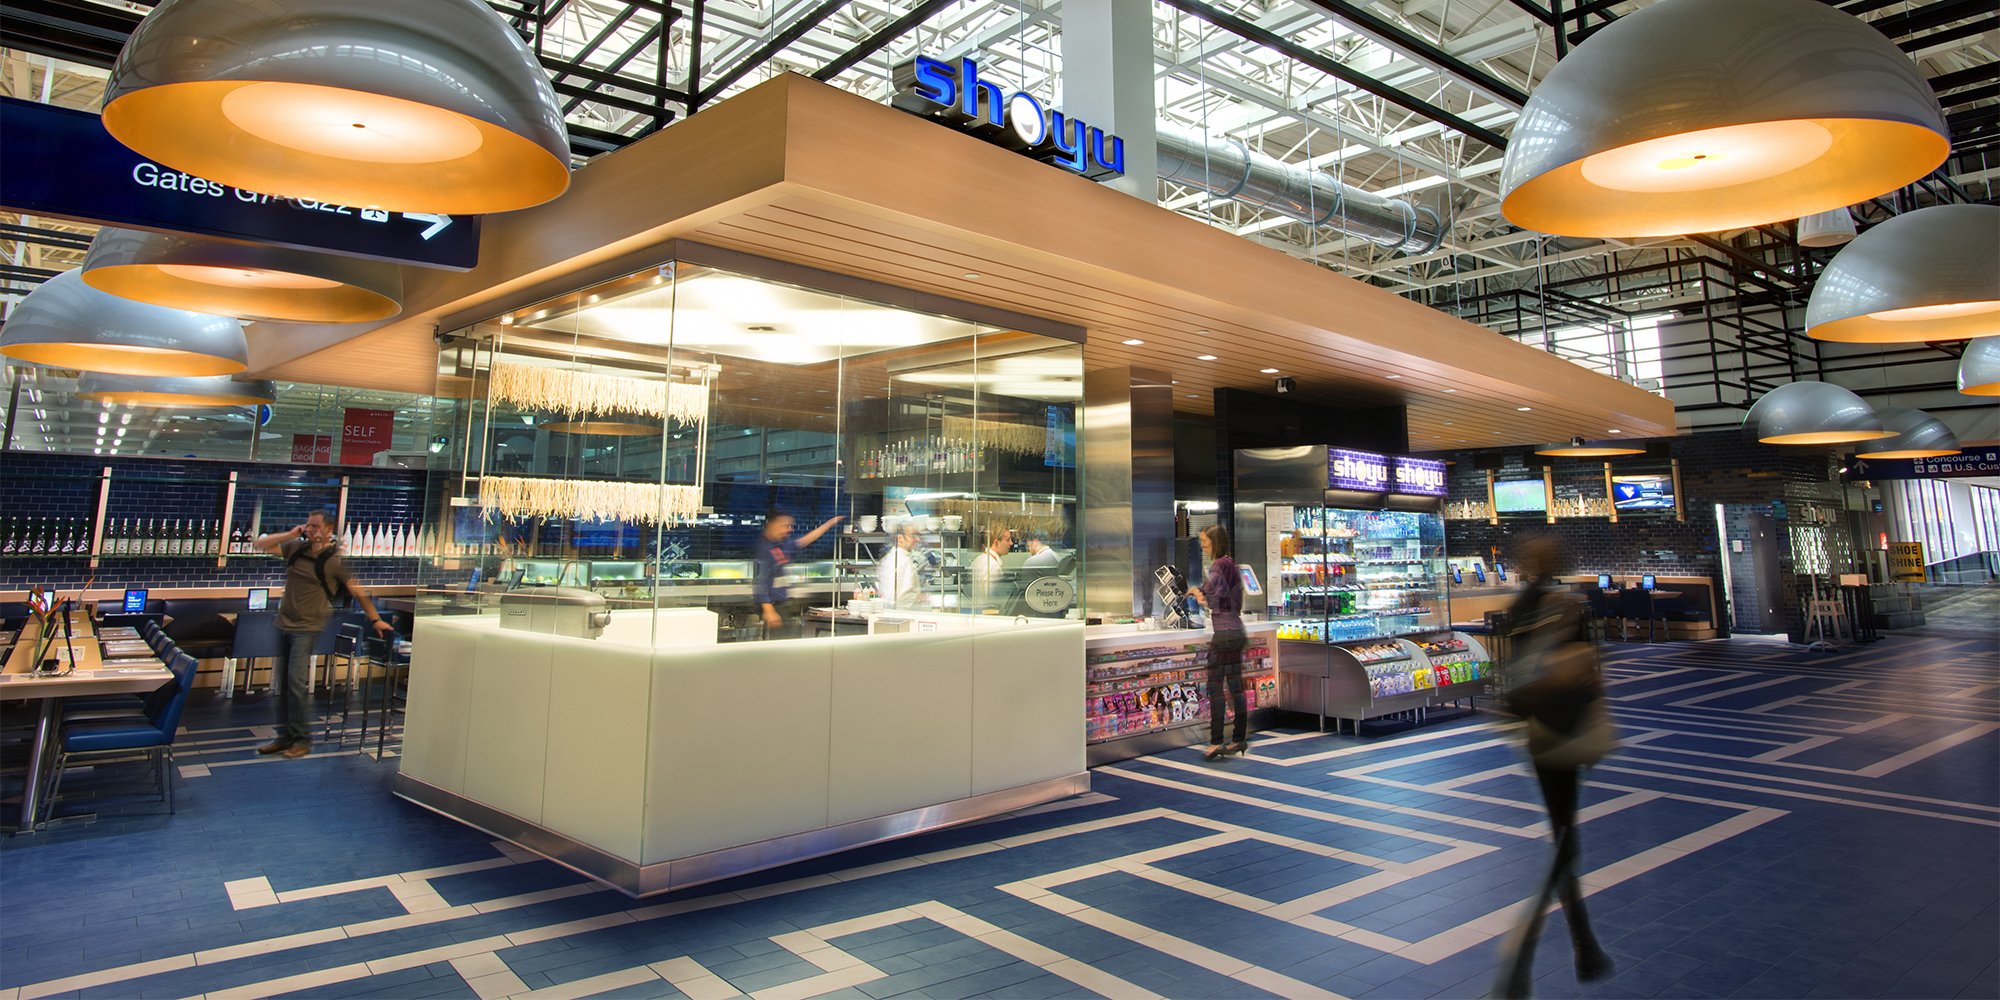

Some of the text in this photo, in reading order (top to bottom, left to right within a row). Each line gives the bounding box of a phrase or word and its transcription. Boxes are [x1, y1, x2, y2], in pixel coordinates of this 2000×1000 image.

[914, 54, 1125, 175] shoyu
[132, 162, 225, 197] Gates
[344, 425, 376, 437] SELF
[1926, 455, 1981, 463] Concourse
[1333, 455, 1388, 486] shoyu
[1979, 463, 2000, 471] Cus
[1395, 463, 1444, 491] shoyu
[1800, 502, 1837, 527] shoyu
[1890, 545, 1918, 555] SHOE
[1890, 558, 1922, 567] SHINE
[1036, 588, 1065, 598] Please Pay
[1043, 599, 1058, 607] Here
